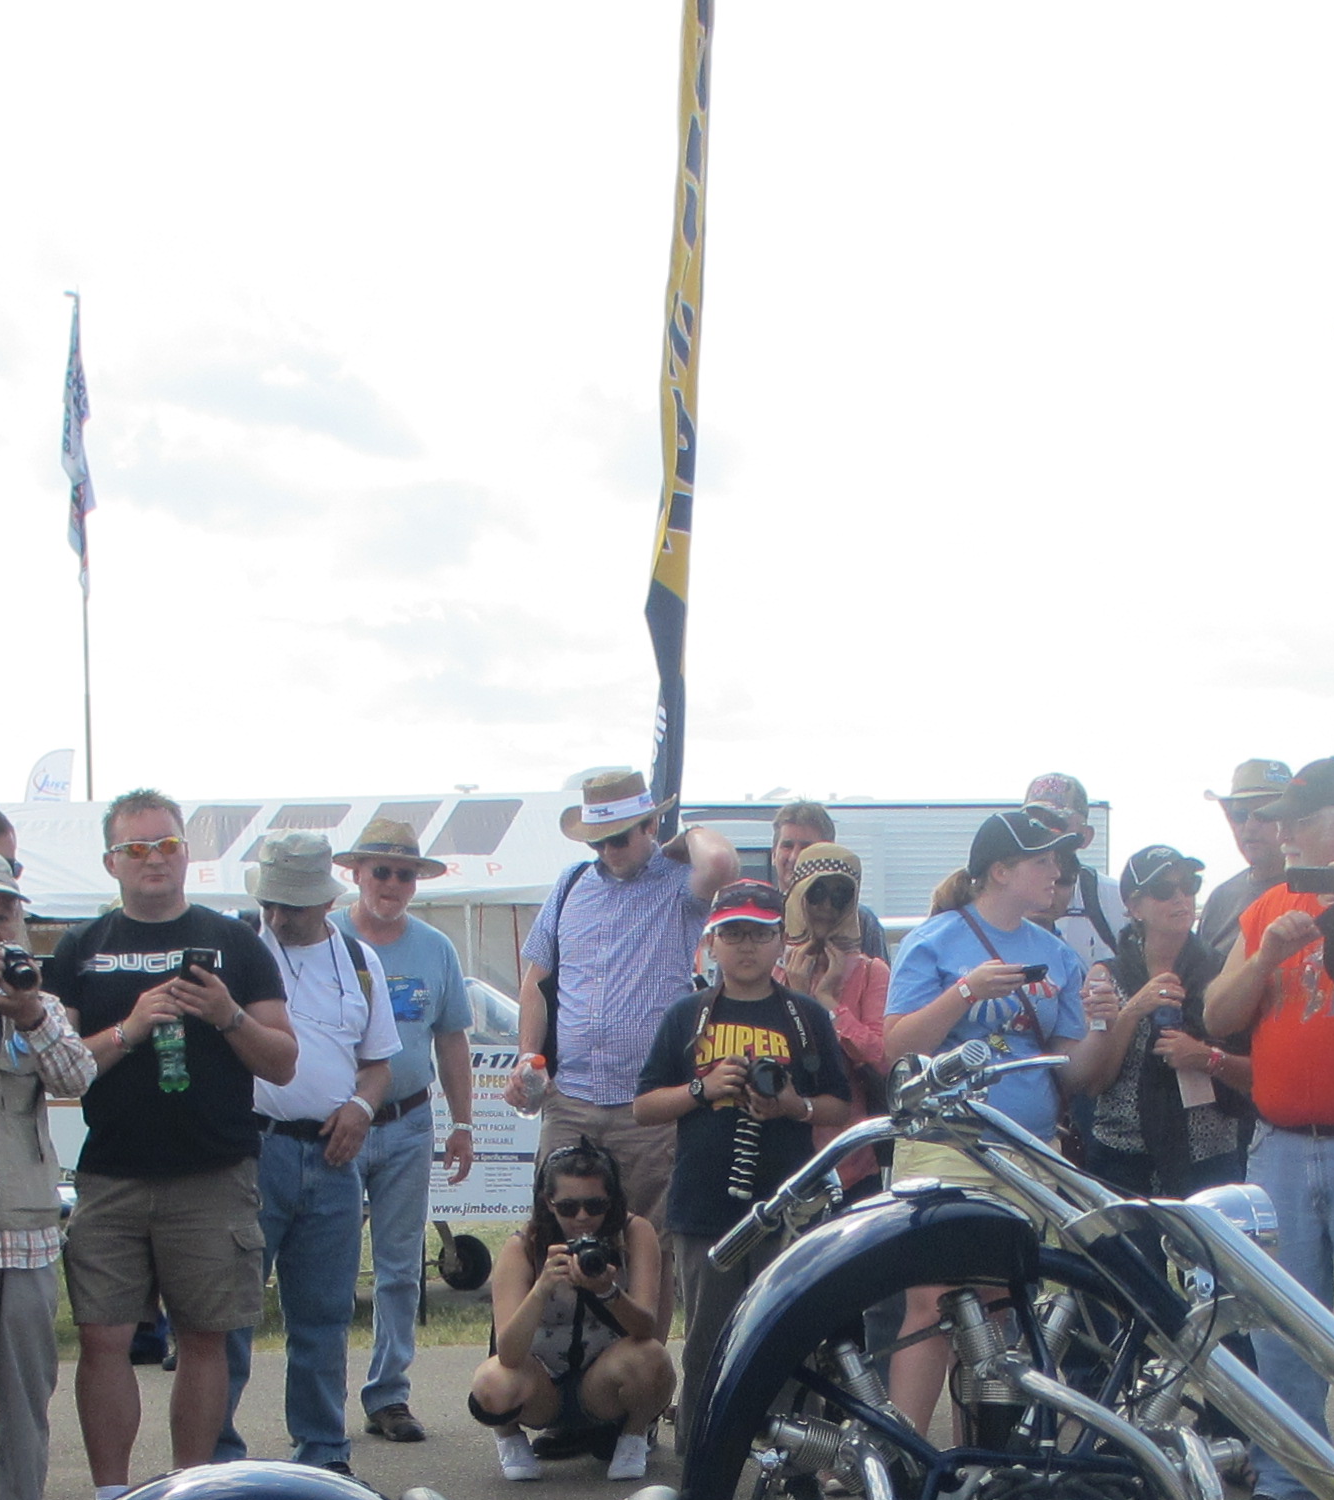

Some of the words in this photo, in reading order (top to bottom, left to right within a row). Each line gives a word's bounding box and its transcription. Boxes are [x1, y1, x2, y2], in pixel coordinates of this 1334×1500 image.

[94, 948, 223, 974] DUCAI
[695, 1023, 791, 1066] SUPER
[478, 1074, 509, 1089] SPEC
